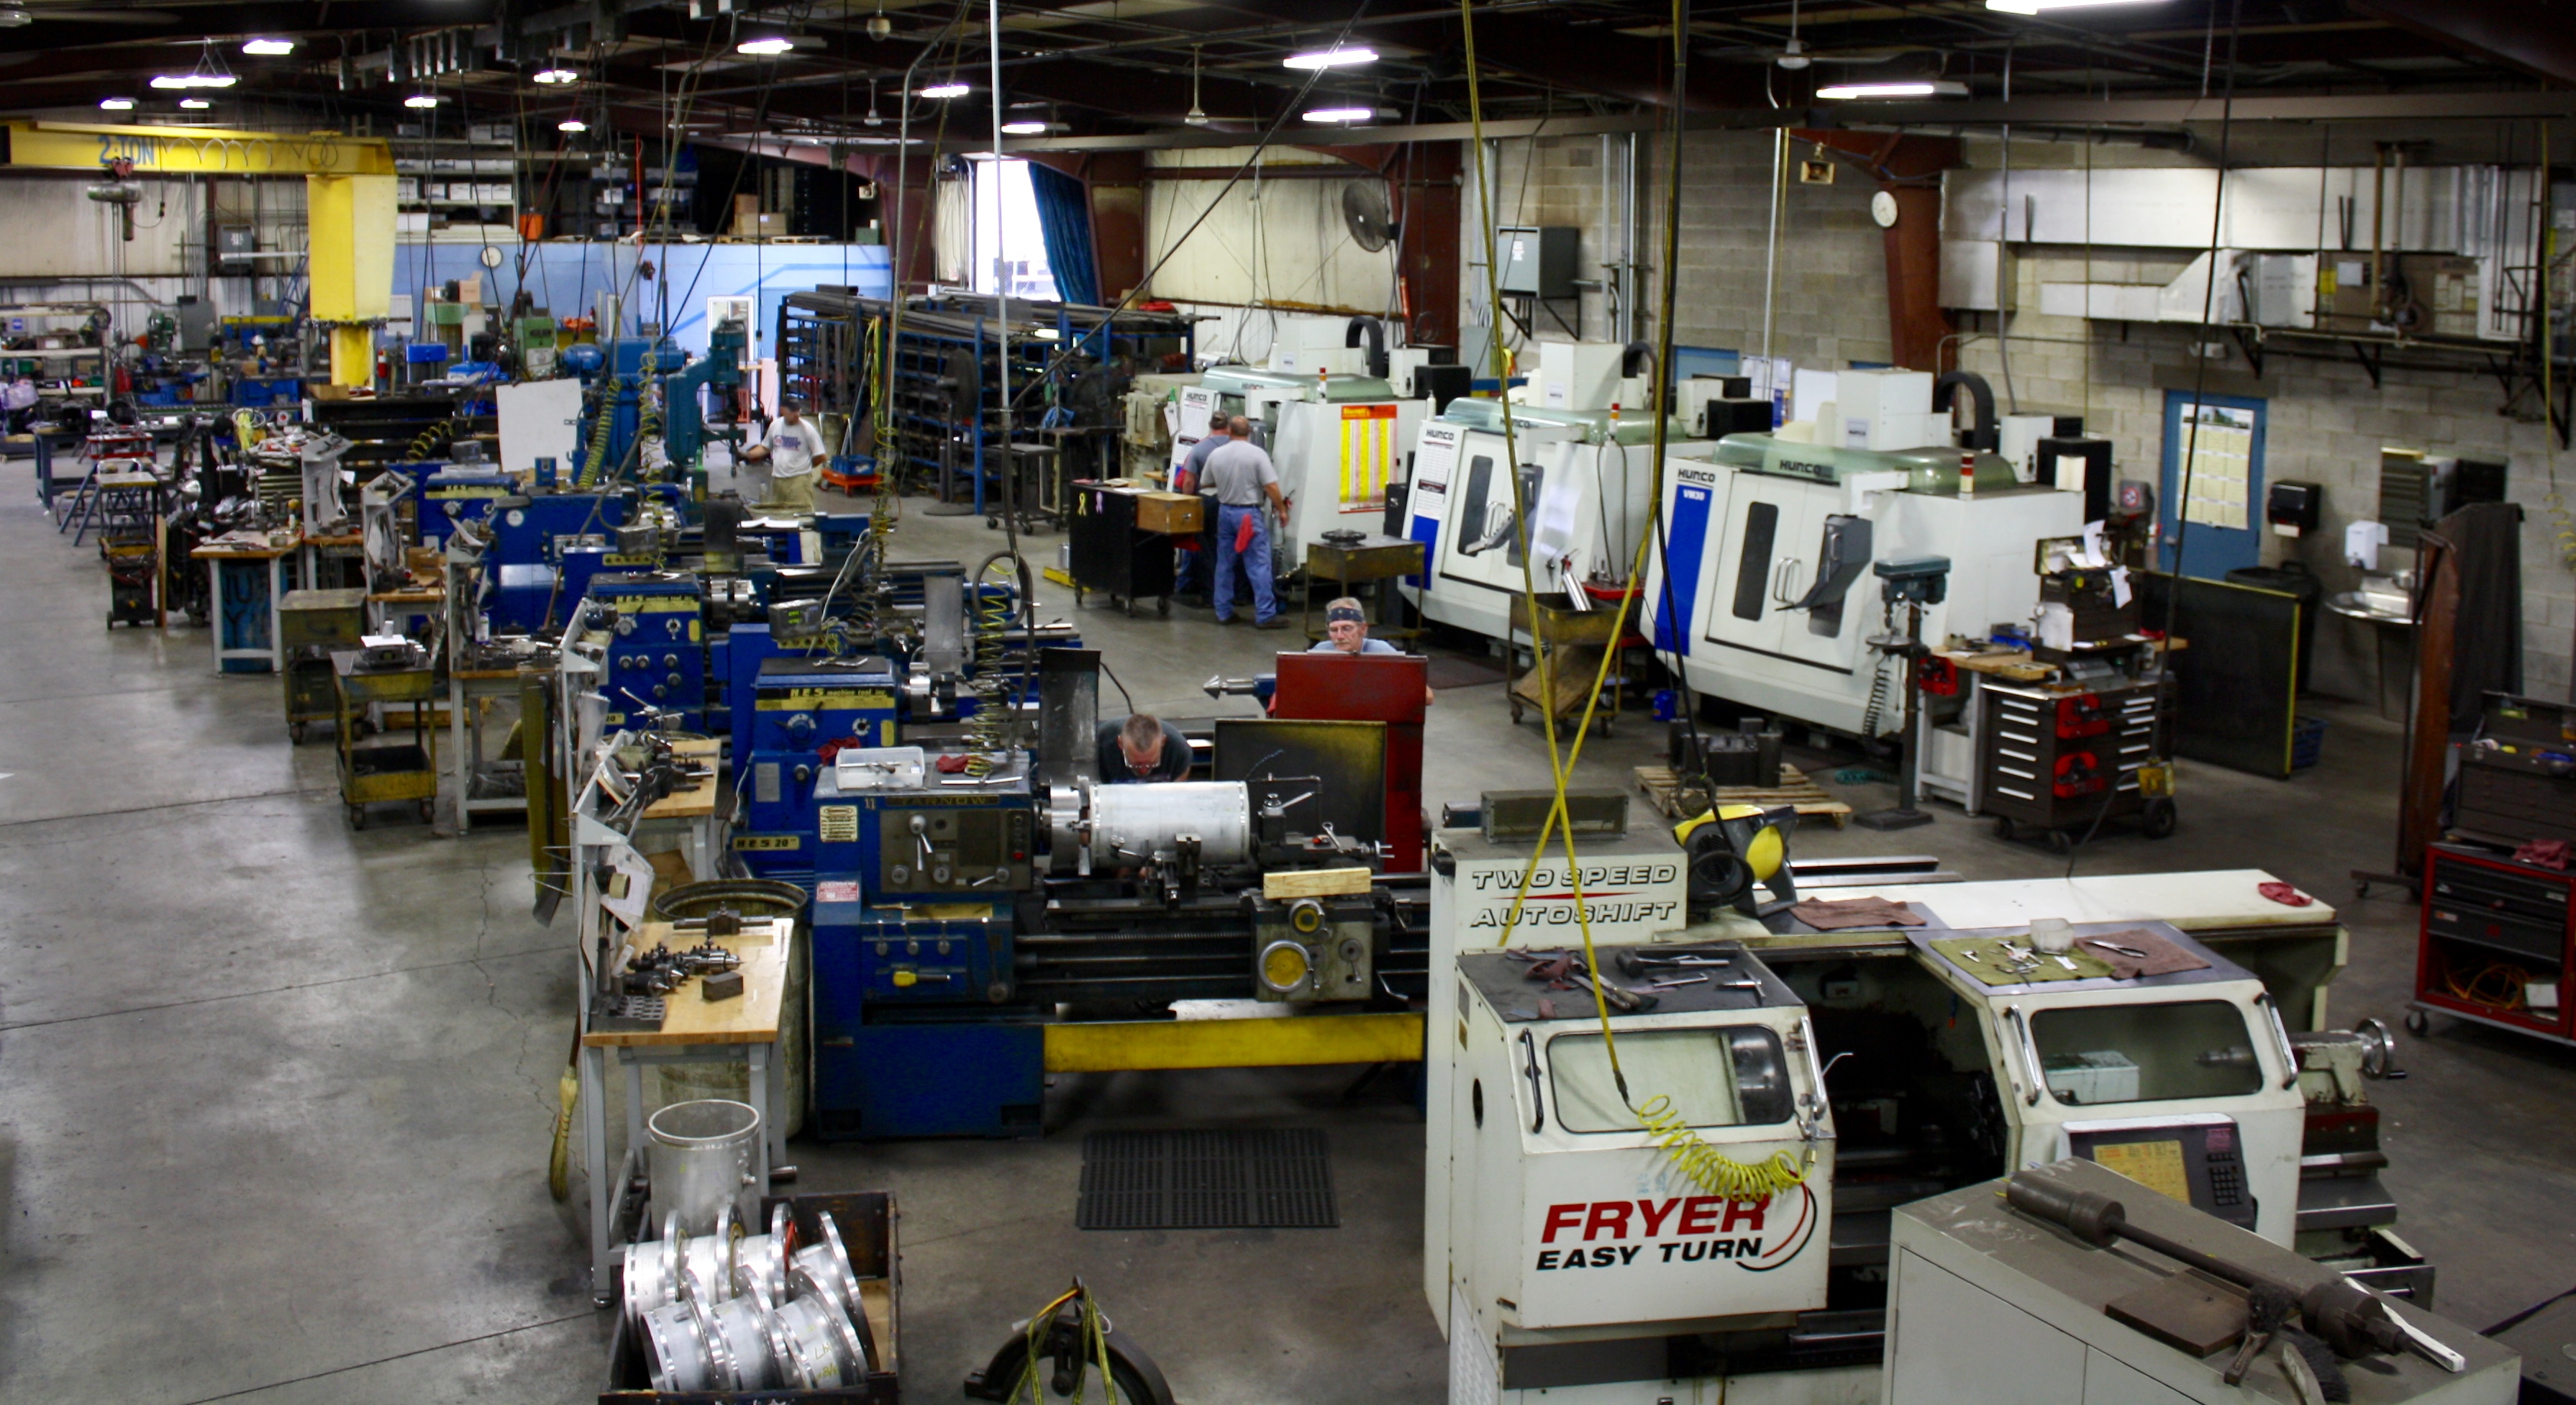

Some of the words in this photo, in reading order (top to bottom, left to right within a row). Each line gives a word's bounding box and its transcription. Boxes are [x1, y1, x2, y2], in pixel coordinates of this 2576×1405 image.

[1426, 429, 1455, 440] HURCO
[1678, 469, 1715, 482] HURCO
[1473, 869, 1554, 890] TWO
[1560, 865, 1677, 886] SPEED
[1470, 901, 1677, 928] AUTOSHIFT
[1541, 1192, 1771, 1244] FRYER
[1536, 1245, 1642, 1270] EASY
[1659, 1237, 1763, 1263] TURN
